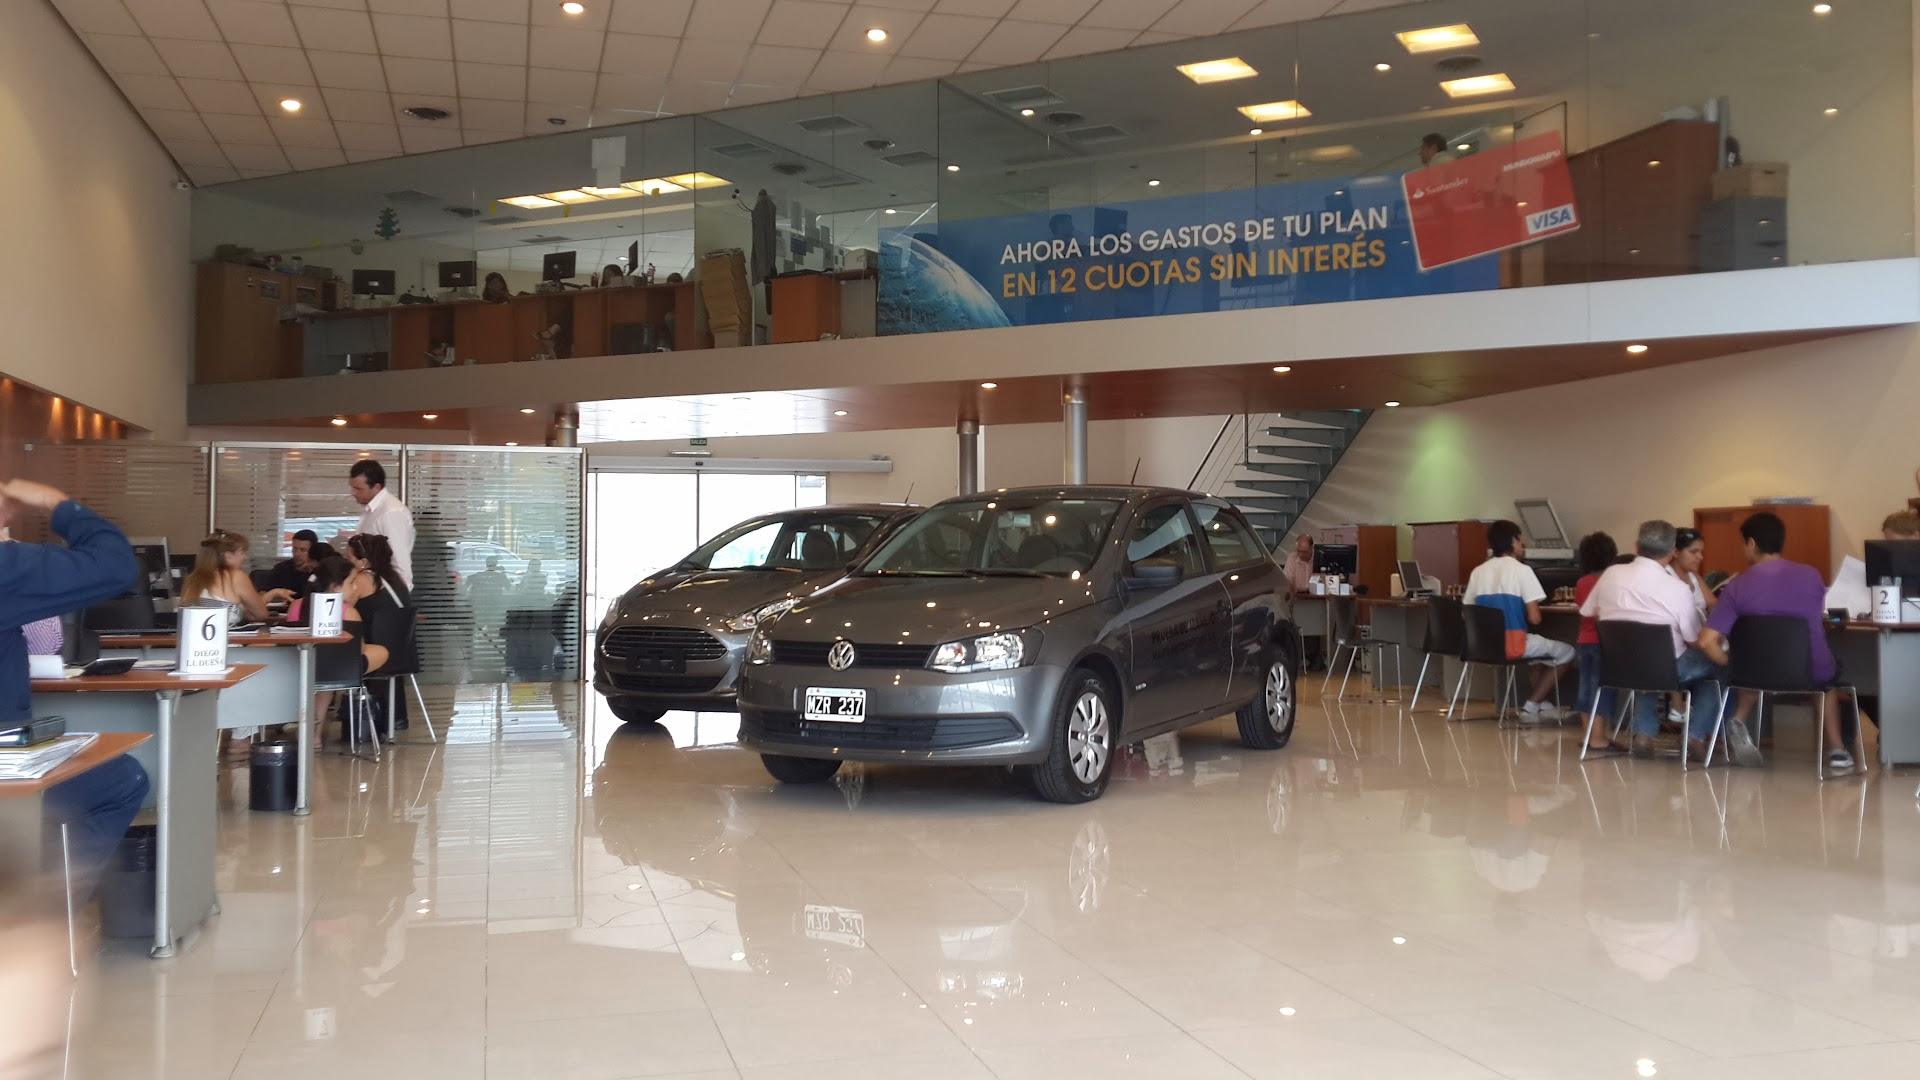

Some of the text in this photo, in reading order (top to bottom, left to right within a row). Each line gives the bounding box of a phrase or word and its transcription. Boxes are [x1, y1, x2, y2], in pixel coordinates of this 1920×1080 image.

[1531, 208, 1571, 230] VISA
[1000, 206, 1388, 264] AHORA LOS GASTOS DE TU PLAN
[1003, 232, 1387, 298] EN 12 CUOTAS SIN INTERÉS
[326, 598, 336, 616] 7
[1880, 590, 1889, 605] 2
[201, 613, 217, 641] 6
[194, 649, 220, 657] DIEGO
[807, 695, 863, 716] MZR 237
